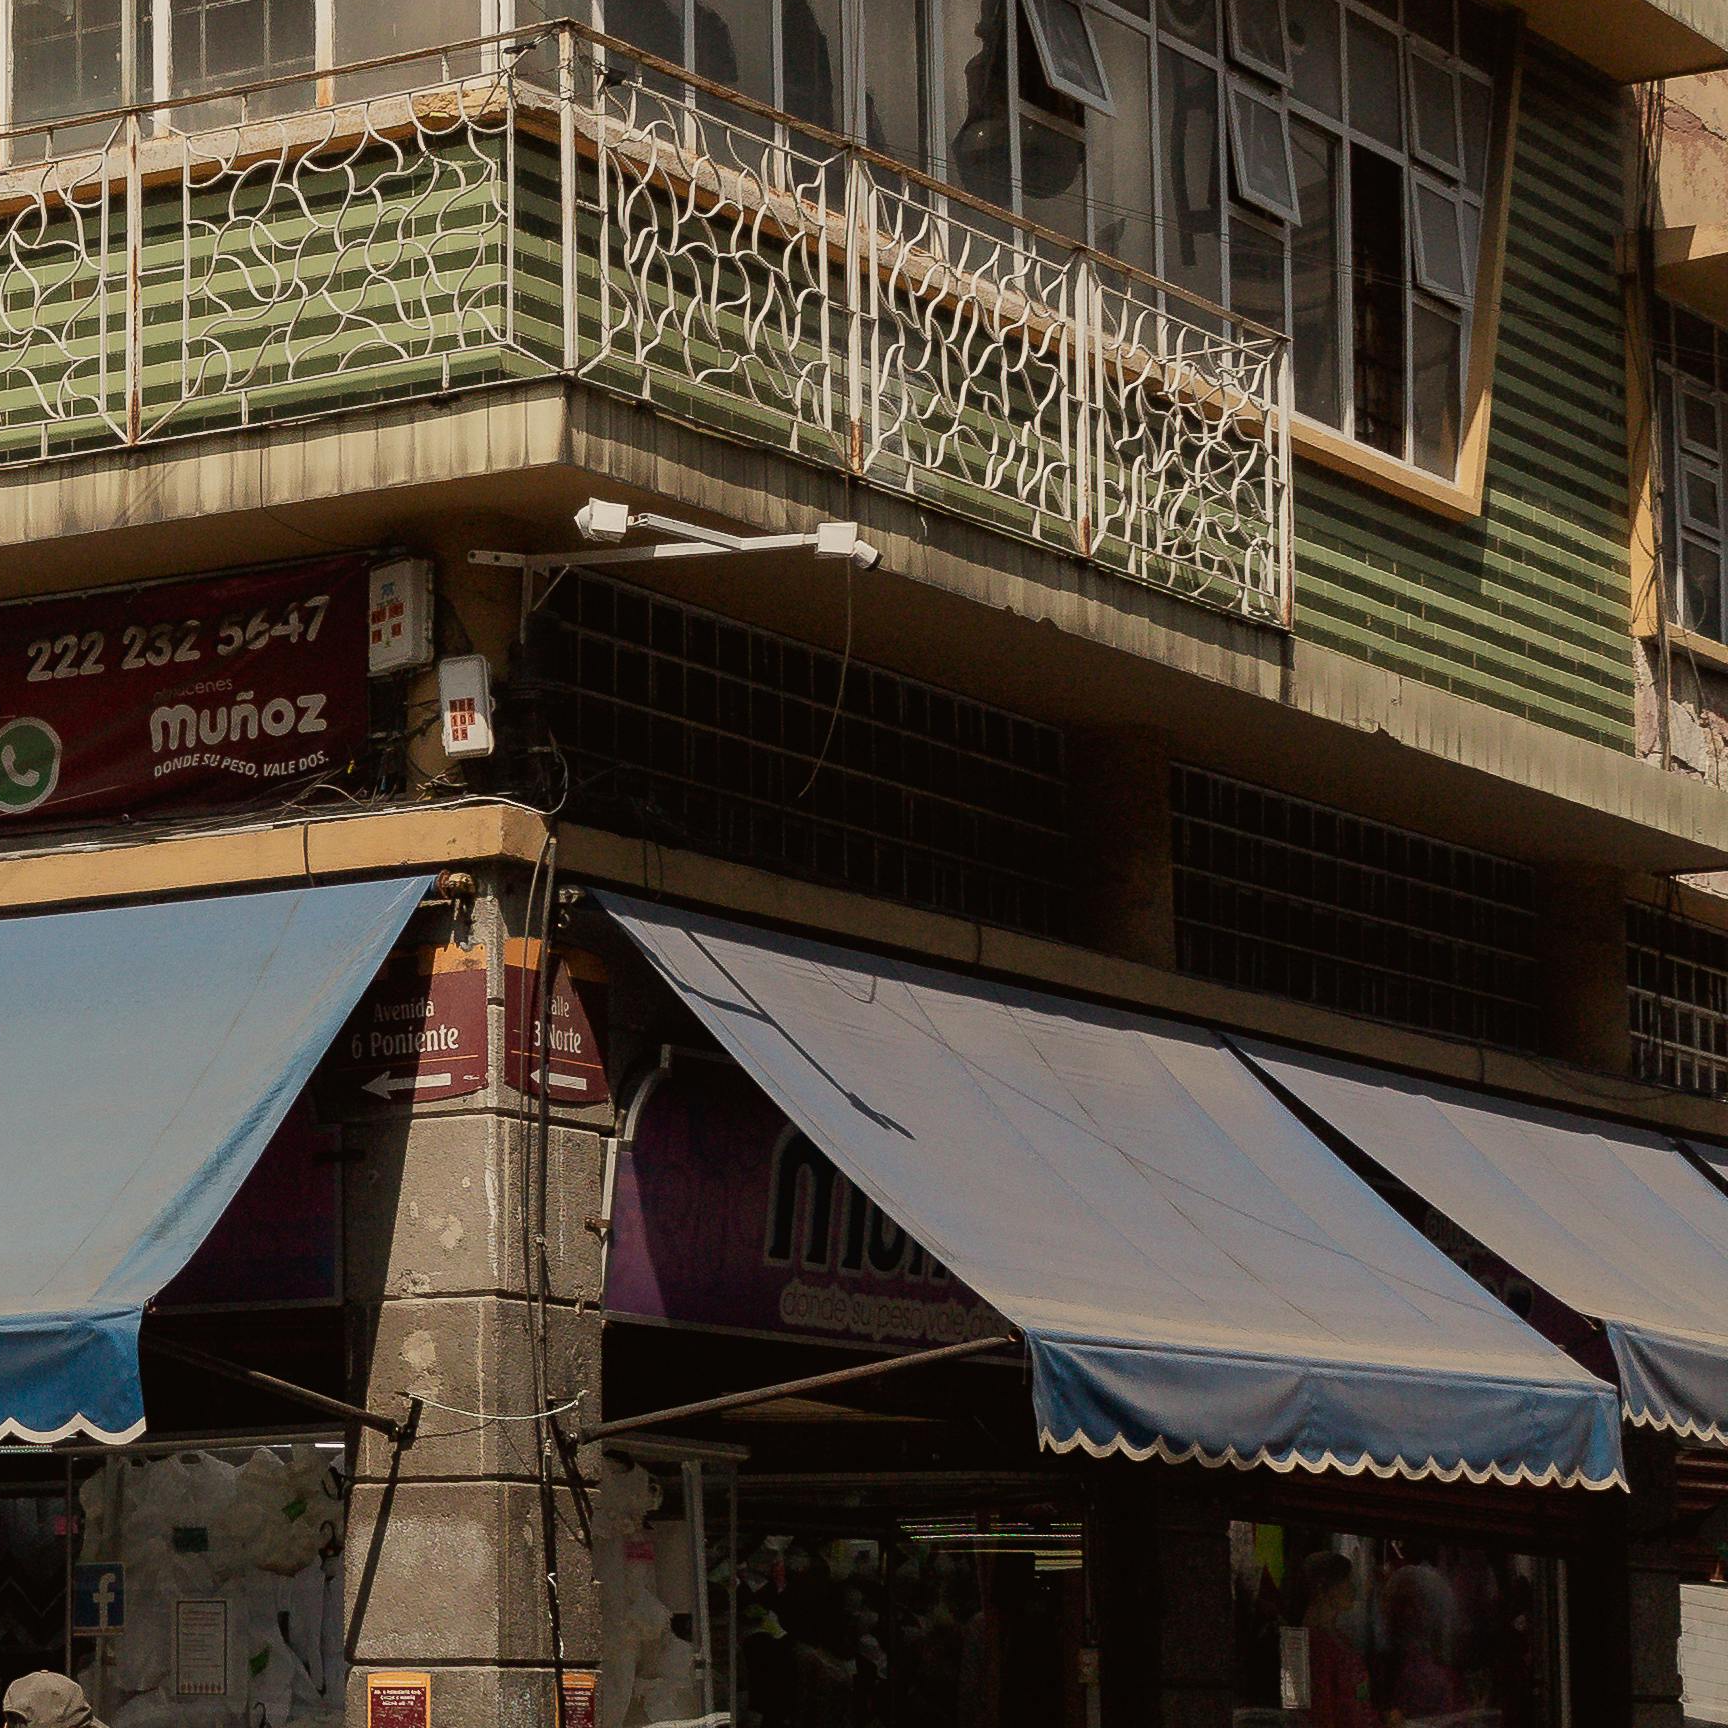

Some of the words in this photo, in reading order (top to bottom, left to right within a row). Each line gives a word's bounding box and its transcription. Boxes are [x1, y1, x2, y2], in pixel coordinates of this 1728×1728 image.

[26, 631, 105, 682] 222
[121, 619, 202, 670] 232
[216, 594, 331, 656] 5647
[153, 754, 200, 778] DONDE
[203, 753, 221, 767] SU
[221, 757, 259, 779] PESO,
[262, 758, 295, 777] VALE
[373, 997, 436, 1023] Avenida
[351, 1032, 363, 1060] 6
[370, 1023, 460, 1058] Poniente
[533, 1020, 541, 1047] 3
[782, 1283, 847, 1322] donde
